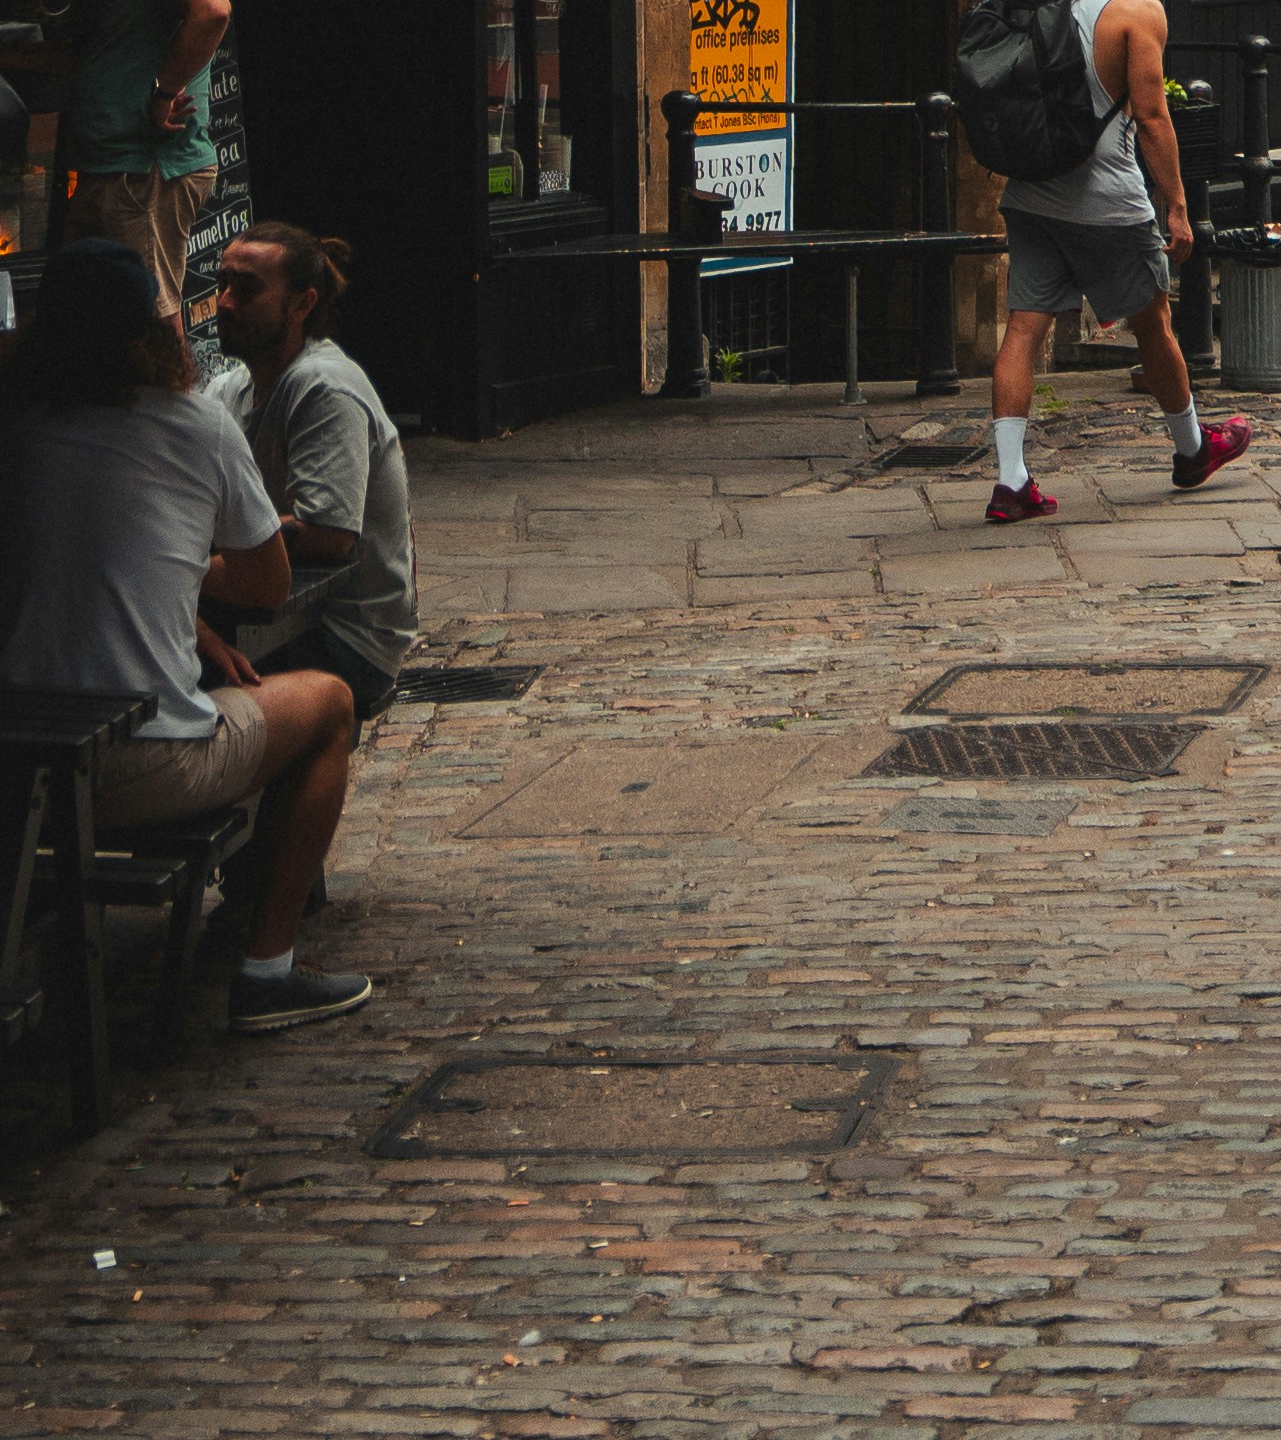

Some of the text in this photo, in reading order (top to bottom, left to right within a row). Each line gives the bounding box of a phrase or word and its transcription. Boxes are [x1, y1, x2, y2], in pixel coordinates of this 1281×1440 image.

[695, 25, 780, 52] office premises
[712, 63, 745, 89] (60.38
[748, 65, 761, 86] sq
[720, 114, 741, 129] Jones
[696, 151, 783, 179] BURSTON
[712, 177, 765, 200] COOK
[745, 210, 782, 232] 9977
